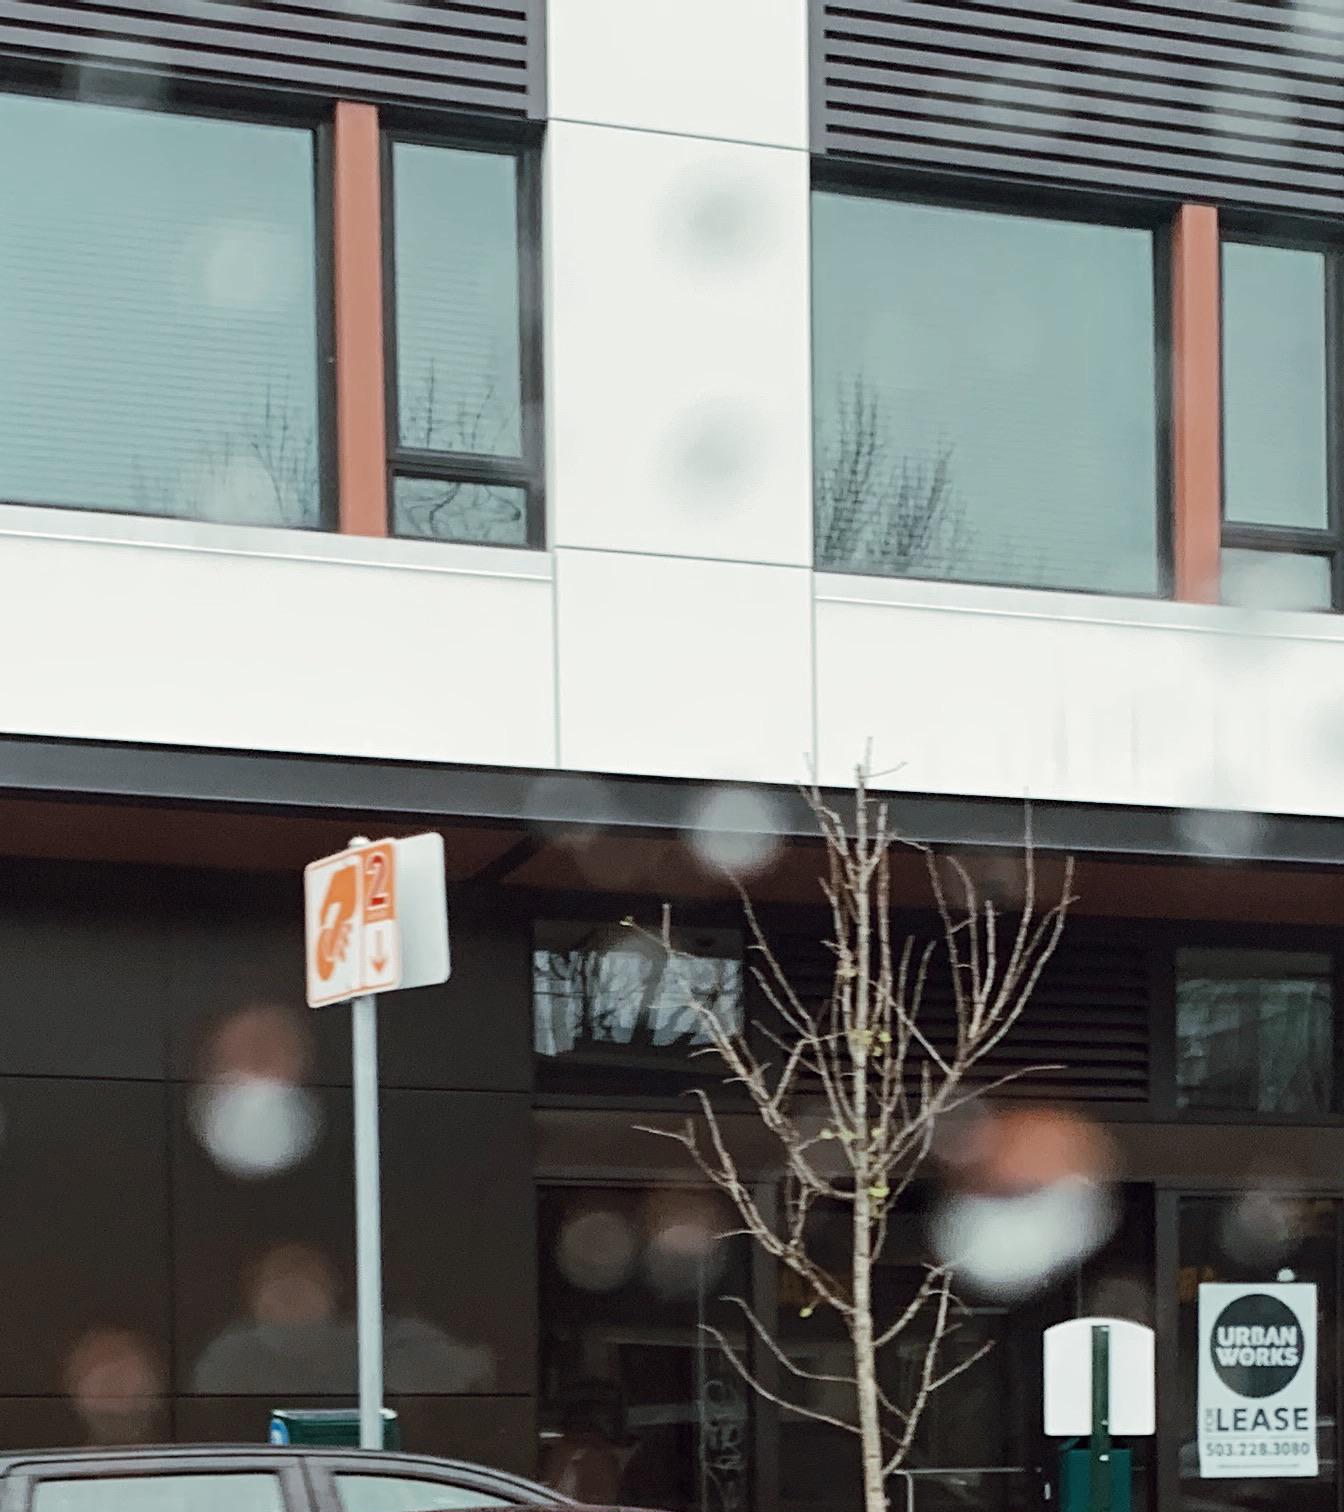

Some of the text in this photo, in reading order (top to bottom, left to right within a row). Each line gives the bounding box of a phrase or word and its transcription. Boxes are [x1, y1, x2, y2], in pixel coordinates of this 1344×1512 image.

[365, 852, 389, 911] 2
[1217, 1325, 1298, 1347] URBAN
[1216, 1347, 1299, 1367] WORKS
[1217, 1407, 1309, 1432] LEASE
